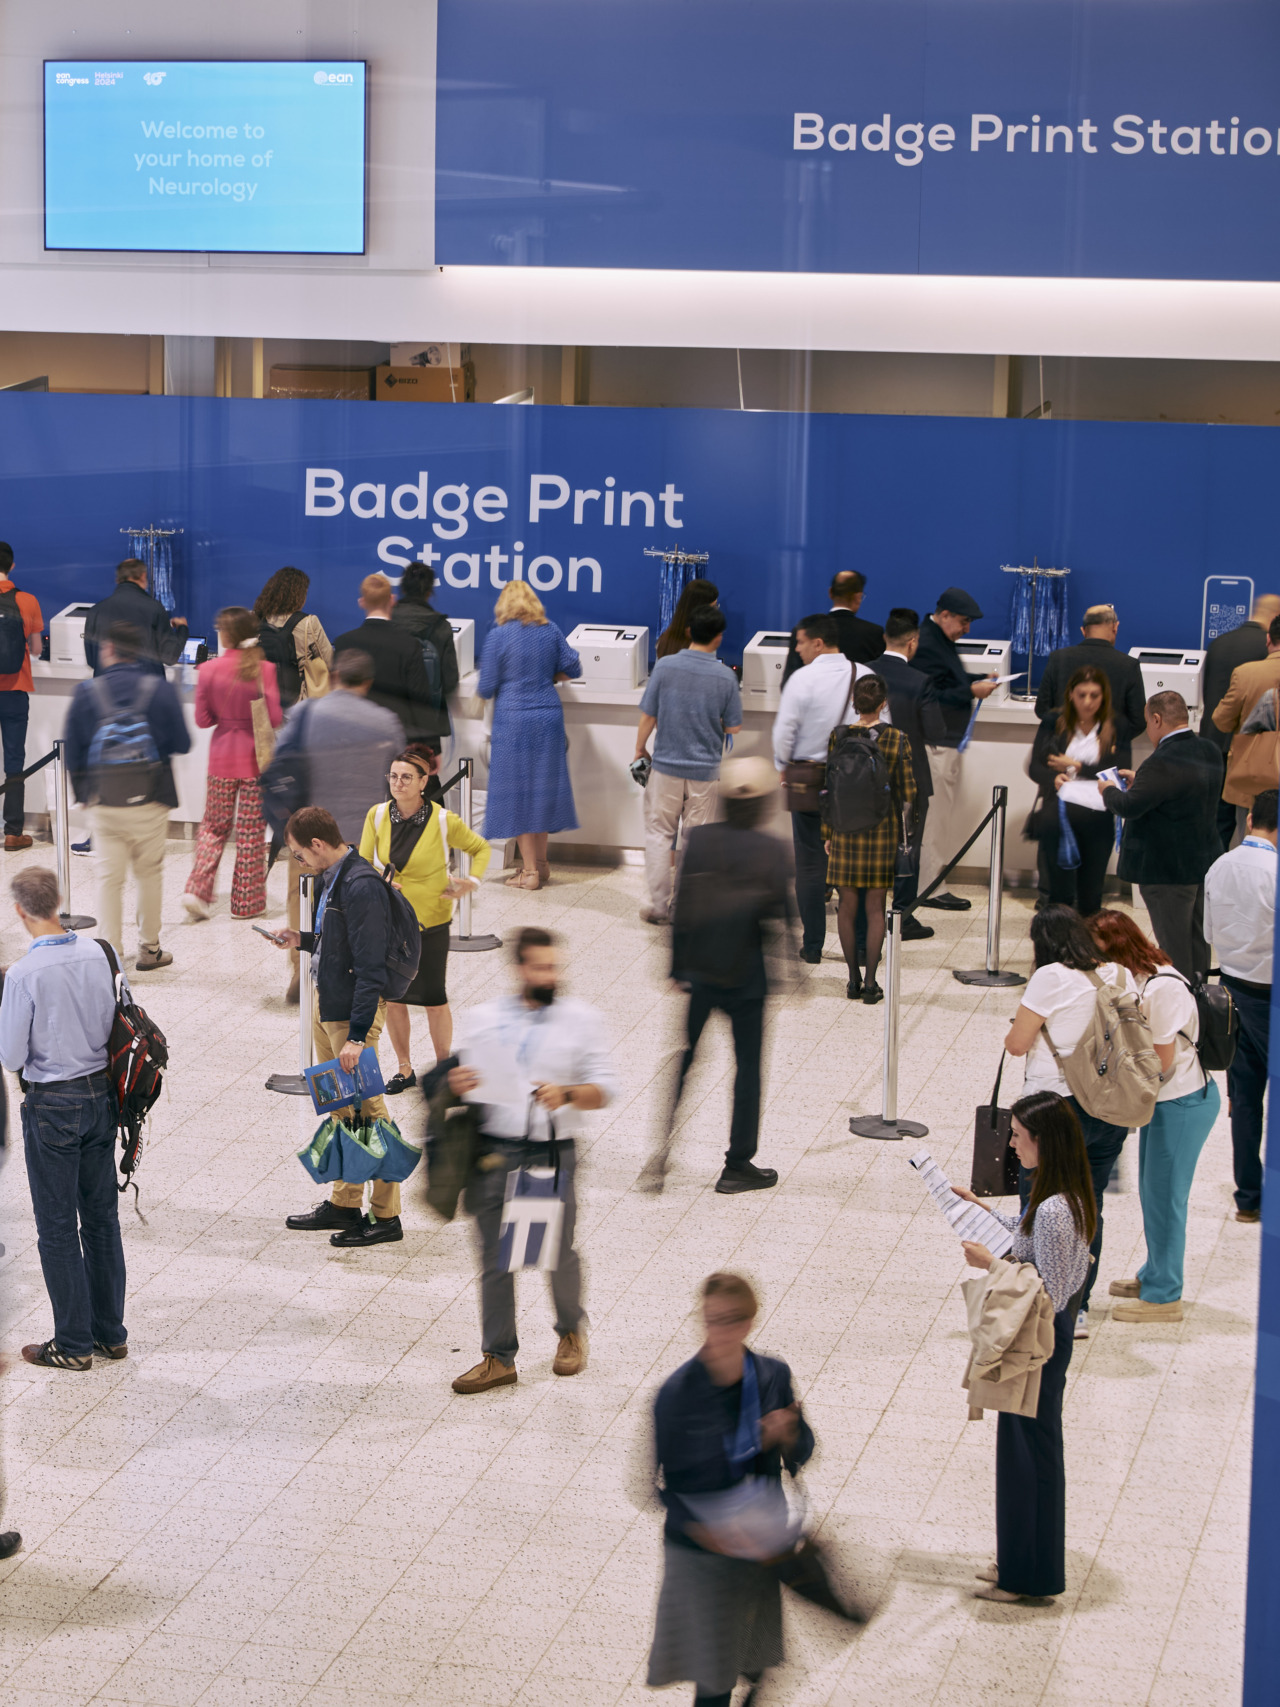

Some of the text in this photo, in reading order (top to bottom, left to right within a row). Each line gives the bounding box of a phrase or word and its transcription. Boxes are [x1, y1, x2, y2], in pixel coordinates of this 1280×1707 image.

[56, 78, 89, 87] congress
[94, 78, 116, 86] 2024
[328, 73, 353, 83] ean
[141, 121, 264, 139] Welcome to
[794, 113, 1280, 166] Badge Print Statio
[134, 150, 273, 171] your home of
[150, 177, 258, 202] Neurology
[305, 468, 683, 540] Badge Print
[376, 535, 601, 593] Station
